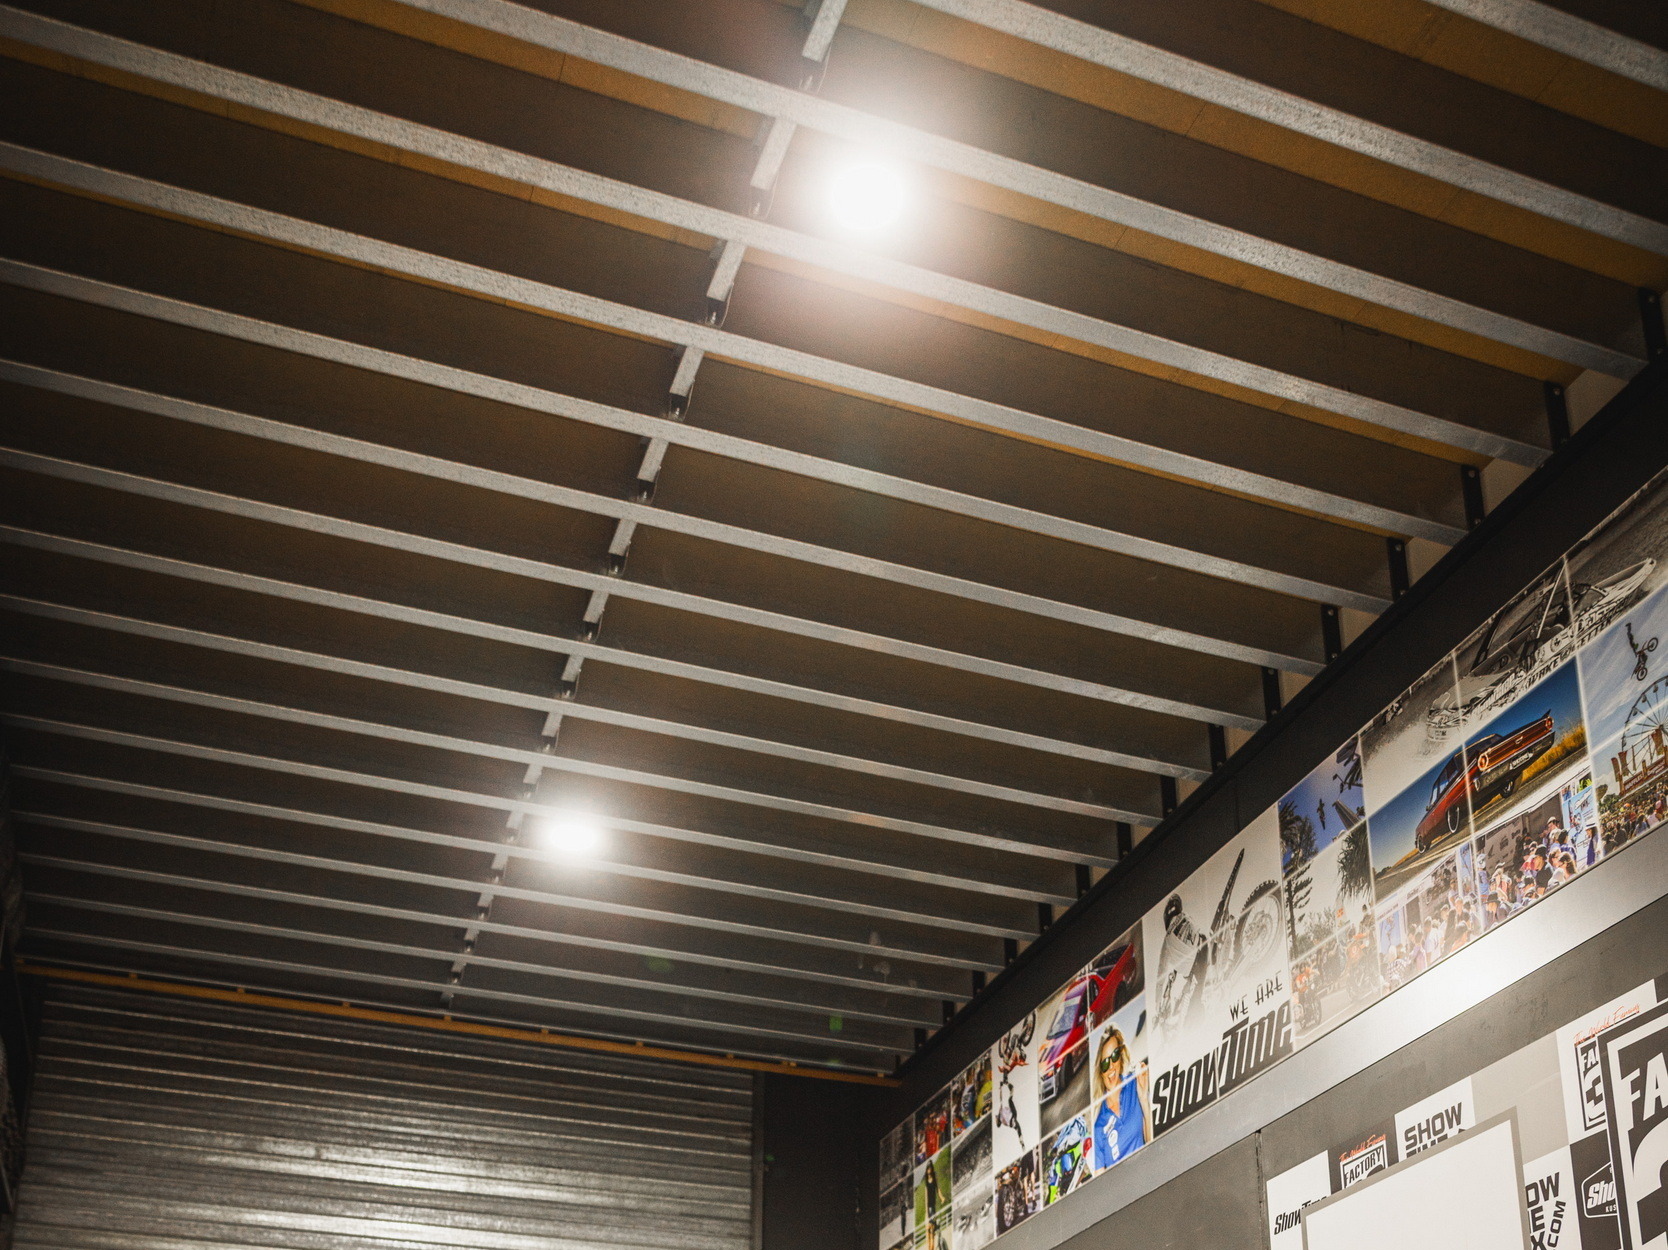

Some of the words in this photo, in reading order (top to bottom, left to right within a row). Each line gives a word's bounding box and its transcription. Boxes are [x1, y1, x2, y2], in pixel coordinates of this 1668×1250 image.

[1229, 994, 1249, 1022] WE
[1255, 970, 1283, 1005] ARE
[1404, 1102, 1462, 1150] SHOW
[1343, 1146, 1382, 1189] FACTORY
